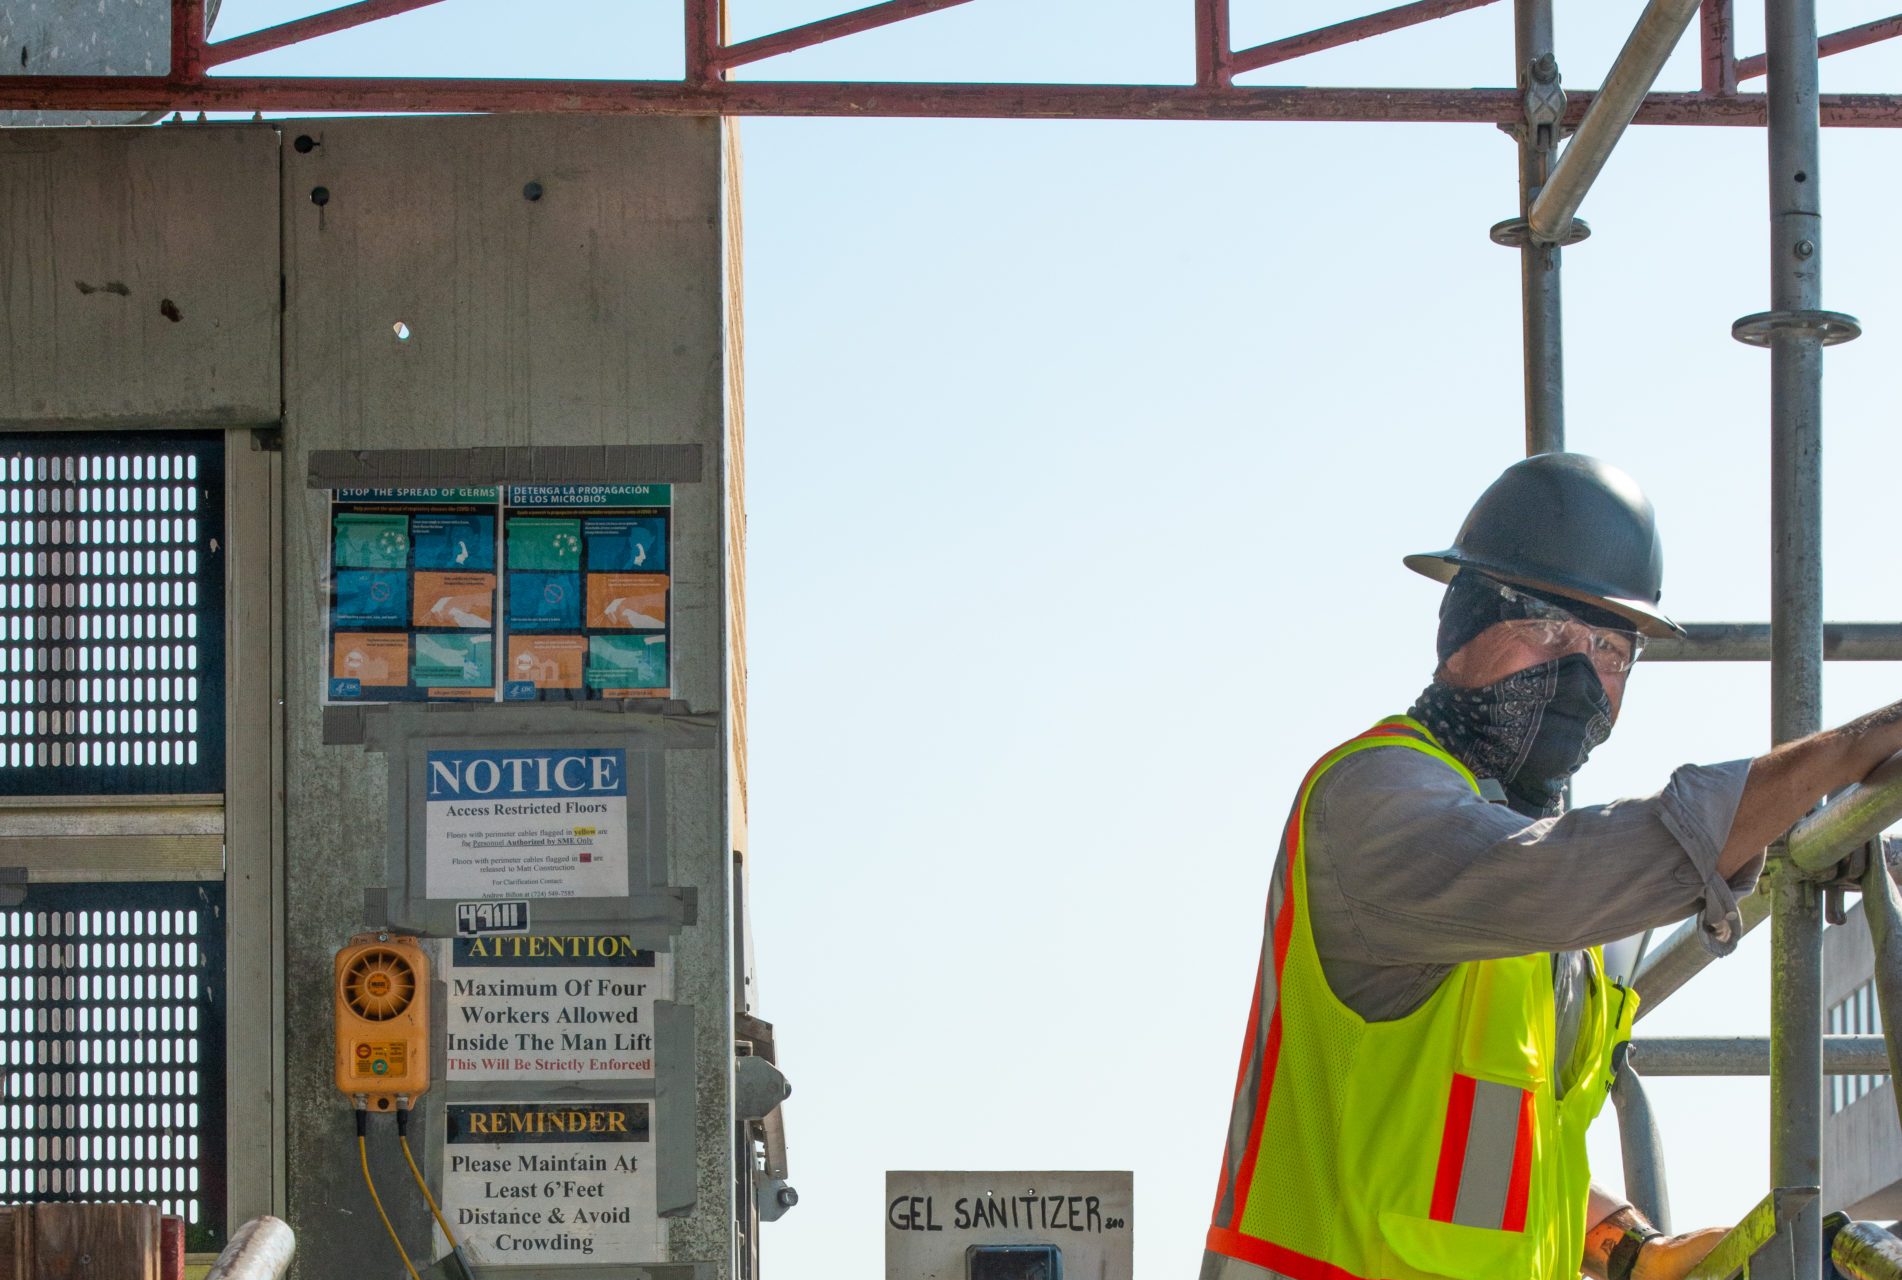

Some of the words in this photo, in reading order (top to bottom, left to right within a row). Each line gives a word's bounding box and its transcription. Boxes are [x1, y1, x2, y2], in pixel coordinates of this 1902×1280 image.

[343, 488, 370, 496] STOP
[373, 488, 393, 496] THE
[397, 488, 438, 496] SPREAD
[460, 489, 495, 497] GERMS
[514, 487, 560, 495] DETENGA
[579, 486, 650, 494] PROPAGACIÓN
[514, 495, 527, 504] DE
[530, 495, 548, 503] LOS
[551, 495, 607, 503] MICROBIOS
[429, 756, 619, 794] NOTICE
[447, 806, 490, 817] Access
[494, 803, 561, 815] Restricted
[567, 802, 607, 814] Floors
[453, 979, 557, 997] Maximum
[565, 979, 591, 996] Of
[596, 980, 646, 996] Four
[461, 1007, 549, 1024] Workers
[557, 1007, 638, 1023] Allowed
[448, 1034, 508, 1050] Inside
[515, 1034, 553, 1050] The
[561, 1034, 607, 1050] Man
[615, 1033, 652, 1050] Lift
[448, 1059, 477, 1071] This
[482, 1059, 509, 1071] Will
[515, 1059, 531, 1070] Be
[536, 1059, 584, 1073] Strictly
[590, 1058, 650, 1070] Enforced
[470, 1112, 627, 1133] REMINDER
[452, 1155, 511, 1172] Please
[518, 1155, 607, 1172] Maintain
[614, 1155, 638, 1171] At
[485, 1182, 536, 1198] Least
[459, 1208, 541, 1224] Distance
[548, 1208, 565, 1224] &
[573, 1207, 630, 1224] Avoid
[889, 1196, 943, 1232] GEL
[954, 1196, 1101, 1233] SANITIZER
[496, 1234, 594, 1254] Crowding
